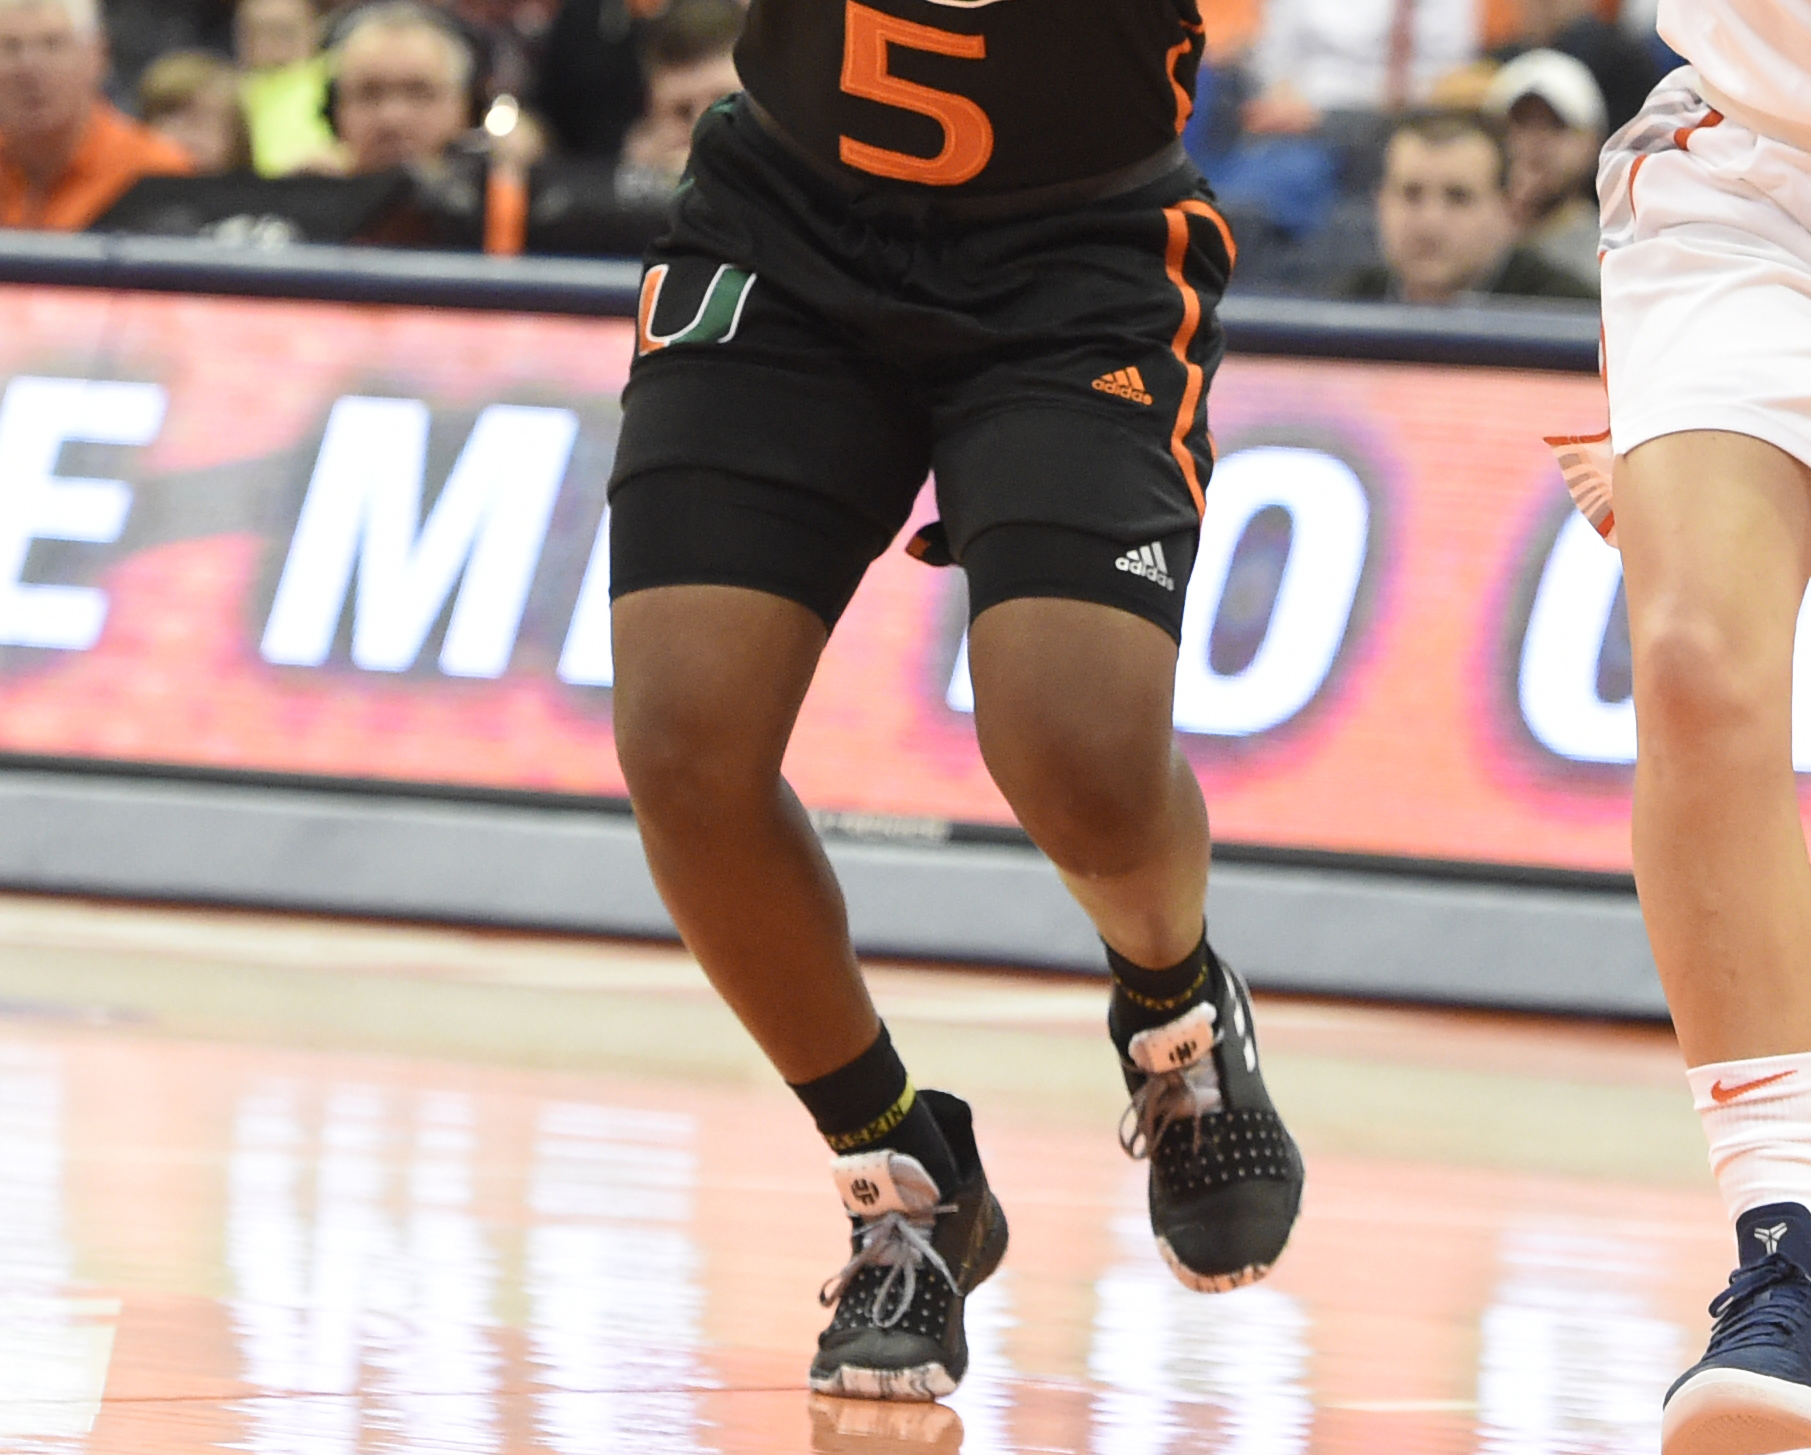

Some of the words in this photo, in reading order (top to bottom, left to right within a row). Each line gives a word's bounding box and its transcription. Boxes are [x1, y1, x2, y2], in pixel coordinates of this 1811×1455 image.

[838, 0, 995, 187] 5
[1091, 379, 1155, 406] adidas
[1114, 557, 1175, 592] adidas
